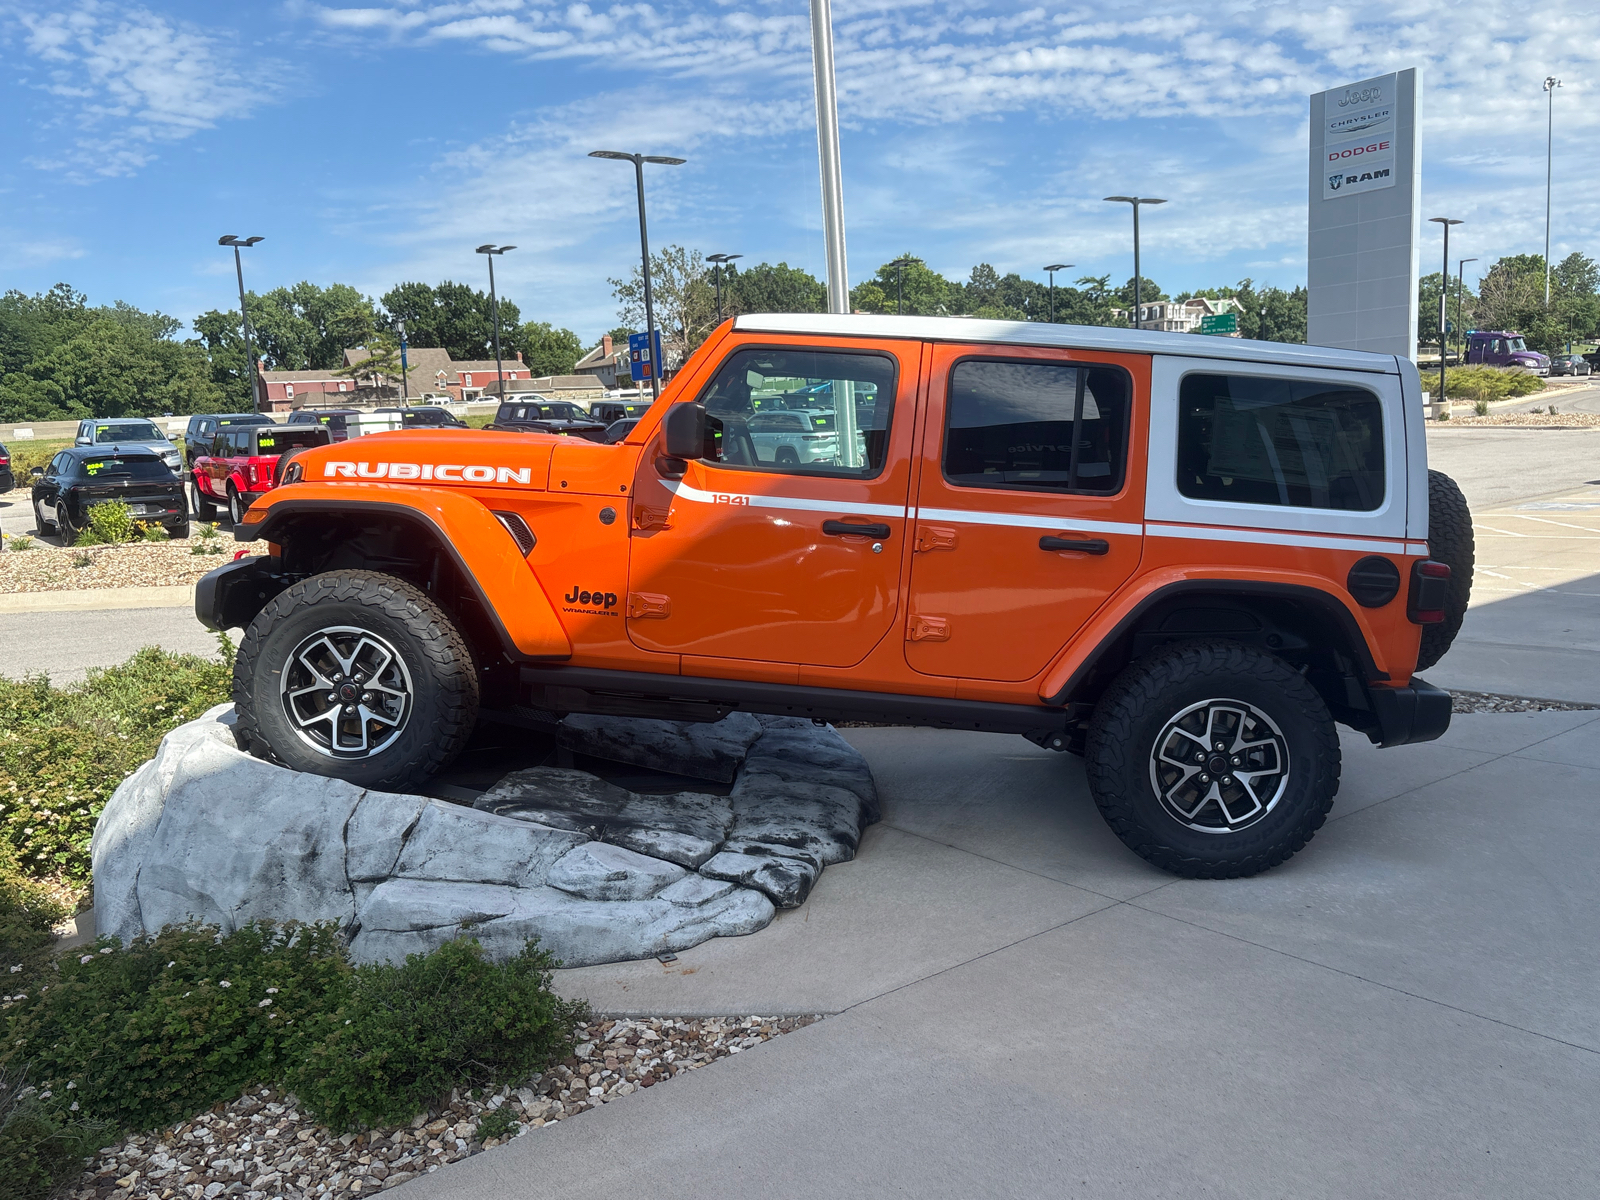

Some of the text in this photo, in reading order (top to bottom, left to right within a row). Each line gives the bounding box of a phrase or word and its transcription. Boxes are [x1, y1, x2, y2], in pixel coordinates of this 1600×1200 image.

[1338, 86, 1382, 107] Jeep
[1330, 110, 1389, 128] CHRYSLER
[1328, 140, 1390, 161] DODGE
[1345, 168, 1390, 185] RAM
[323, 461, 532, 484] RUBICON
[712, 494, 749, 507] 1941
[565, 585, 618, 609] Jeep
[562, 607, 610, 616] WRANGLER
